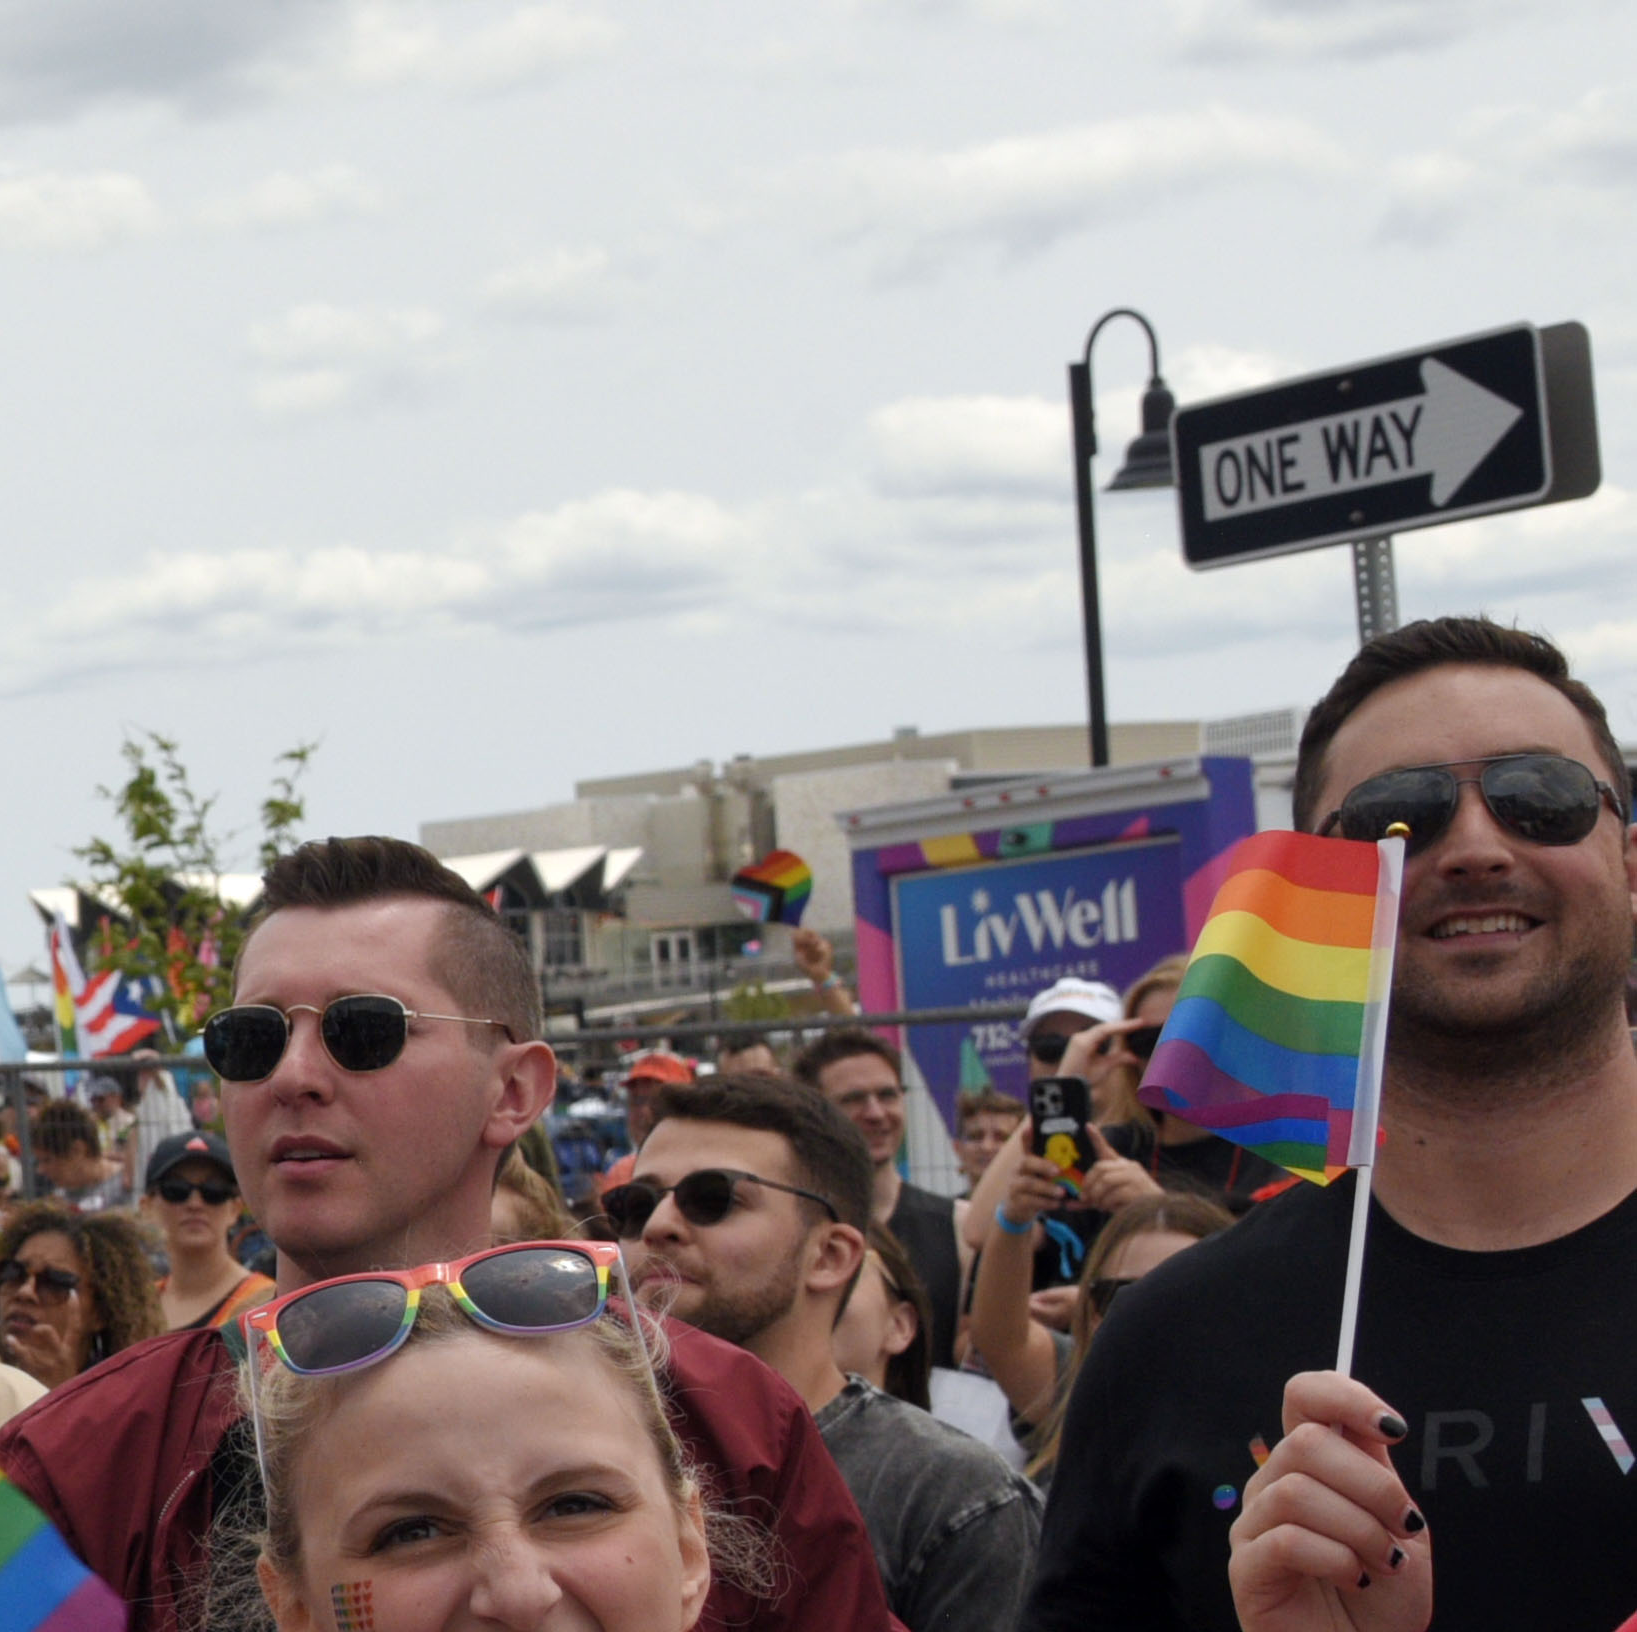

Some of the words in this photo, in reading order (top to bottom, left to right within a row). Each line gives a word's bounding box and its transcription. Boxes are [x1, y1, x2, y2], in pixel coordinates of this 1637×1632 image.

[1215, 433, 1306, 508] ONE
[1321, 404, 1423, 484] WAY
[939, 877, 1139, 967] LivWell
